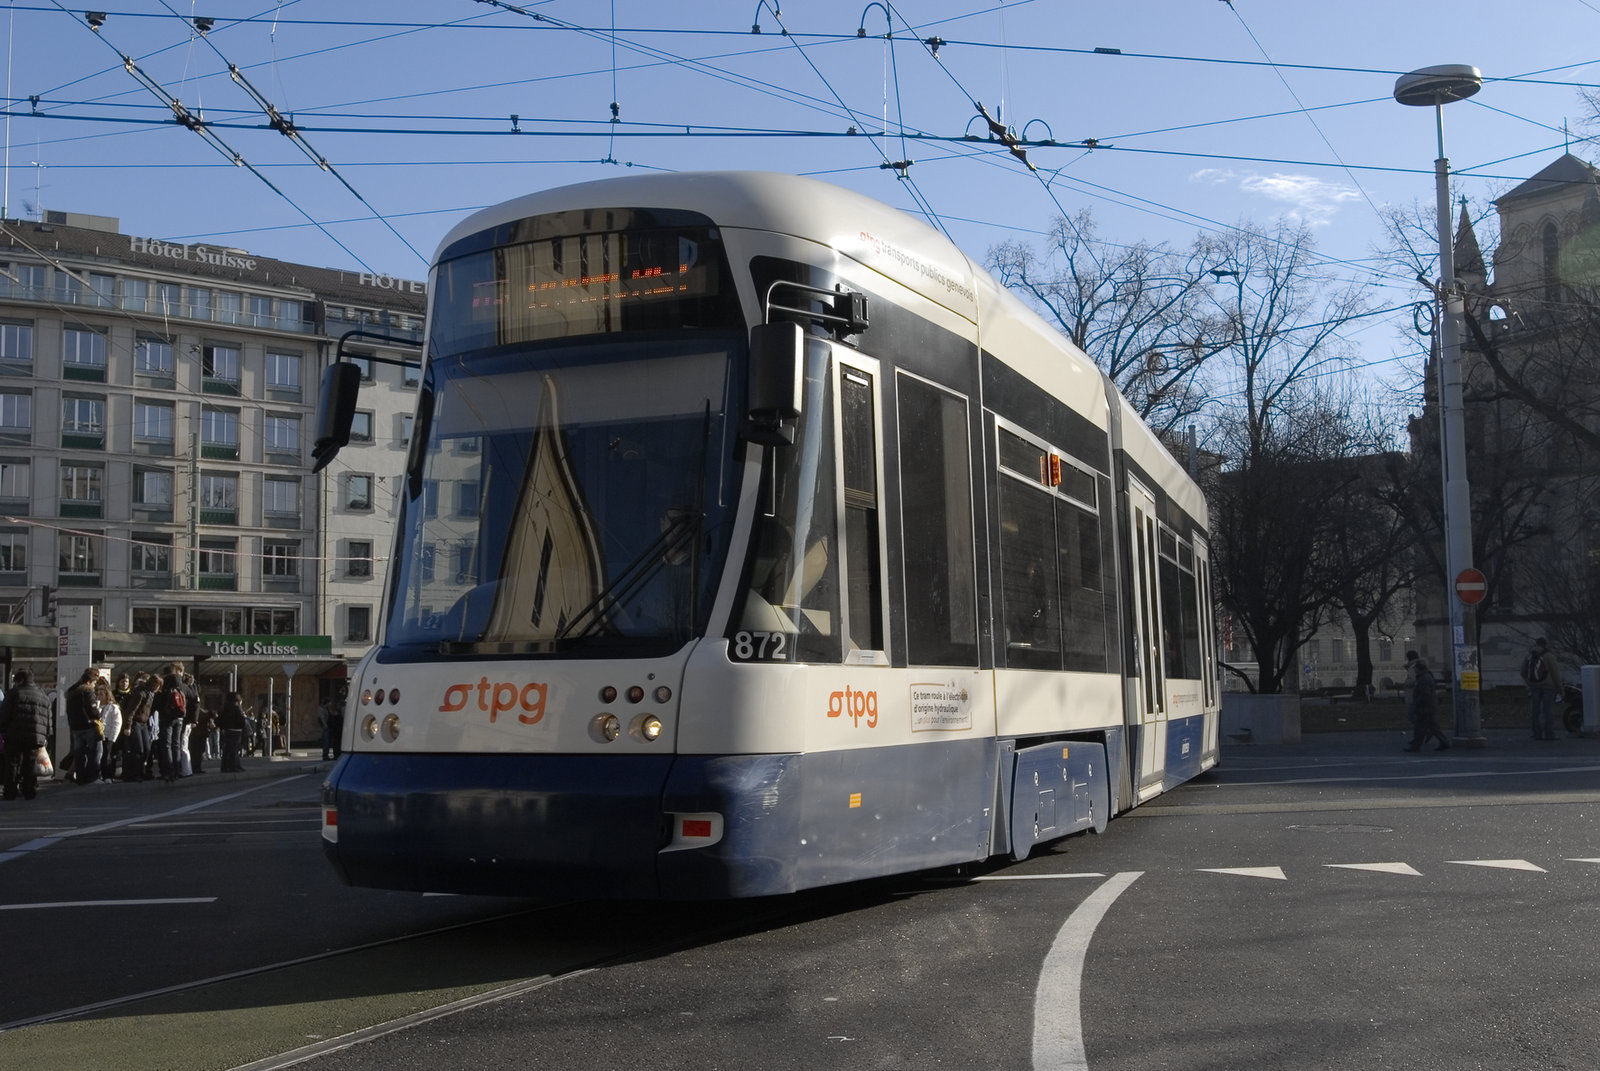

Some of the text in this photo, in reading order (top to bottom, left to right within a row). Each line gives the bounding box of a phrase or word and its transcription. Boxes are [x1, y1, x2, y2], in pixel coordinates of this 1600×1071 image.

[130, 236, 257, 271] Hôtel Suisse
[881, 240, 920, 273] transports
[920, 264, 946, 286] publics
[946, 279, 974, 302] genevois
[206, 639, 299, 655] Hôtel Suisse
[735, 631, 787, 660] 872
[920, 691, 931, 700] tram
[931, 691, 943, 700] roule
[913, 703, 959, 715] d'origine hydraulique
